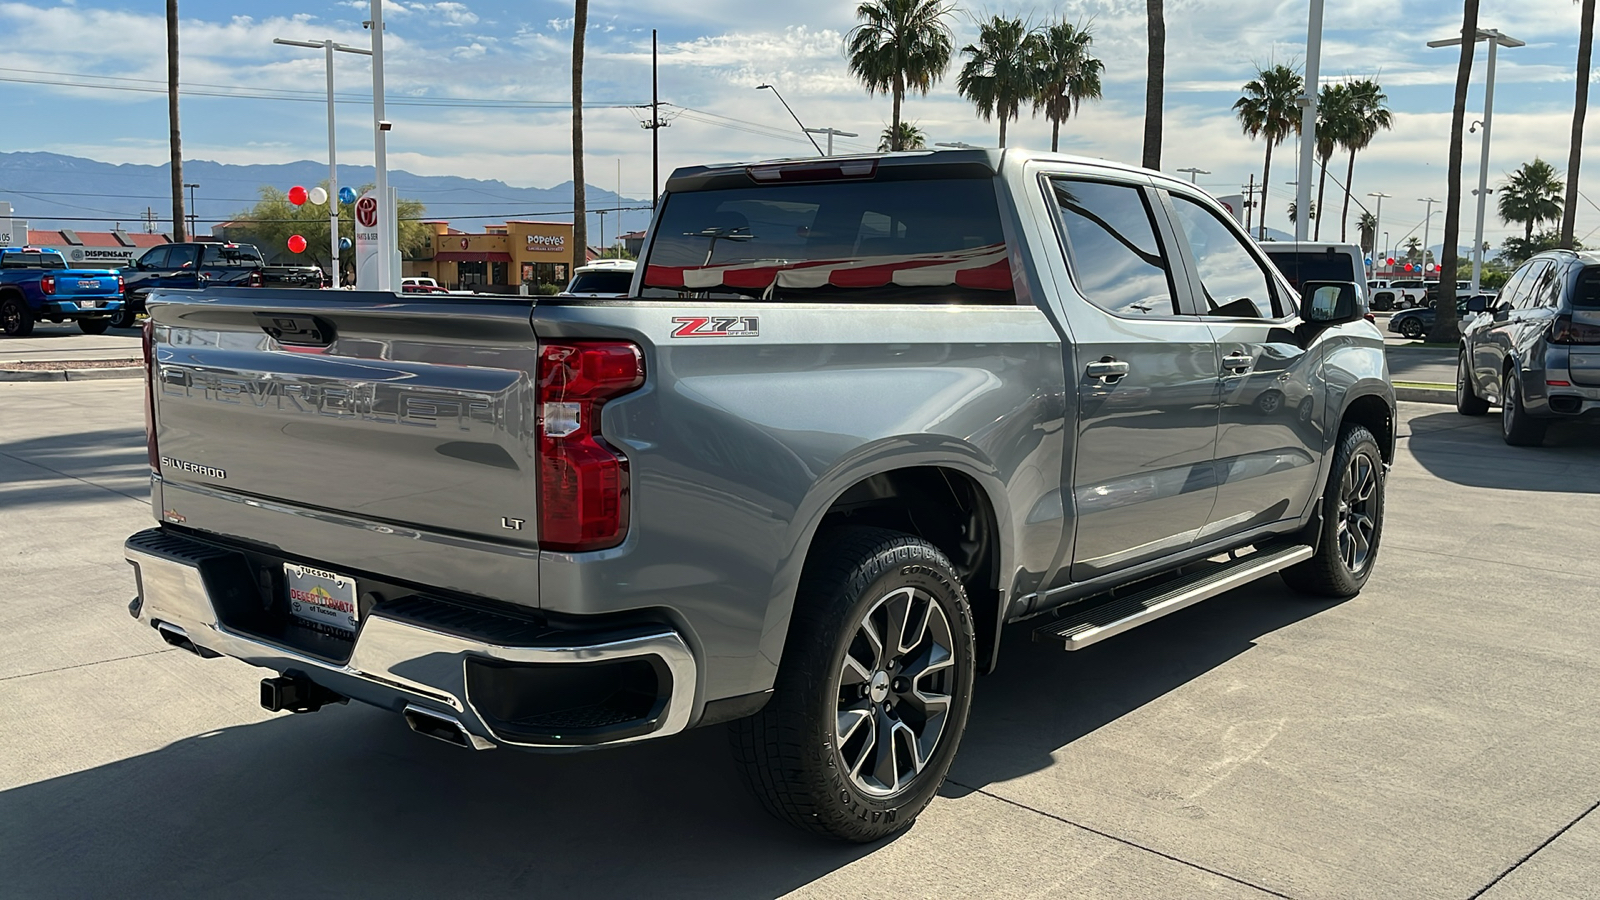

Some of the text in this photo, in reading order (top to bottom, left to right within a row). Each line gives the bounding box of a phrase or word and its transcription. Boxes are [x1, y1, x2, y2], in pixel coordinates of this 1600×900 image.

[671, 316, 759, 338] Z71
[161, 366, 490, 432] CHEVROLET
[161, 456, 227, 479] SILVERADO
[501, 516, 526, 530] LT
[300, 566, 336, 579] TUCSON
[291, 588, 354, 613] DESERT TOYOTA
[317, 606, 337, 617] Tucson
